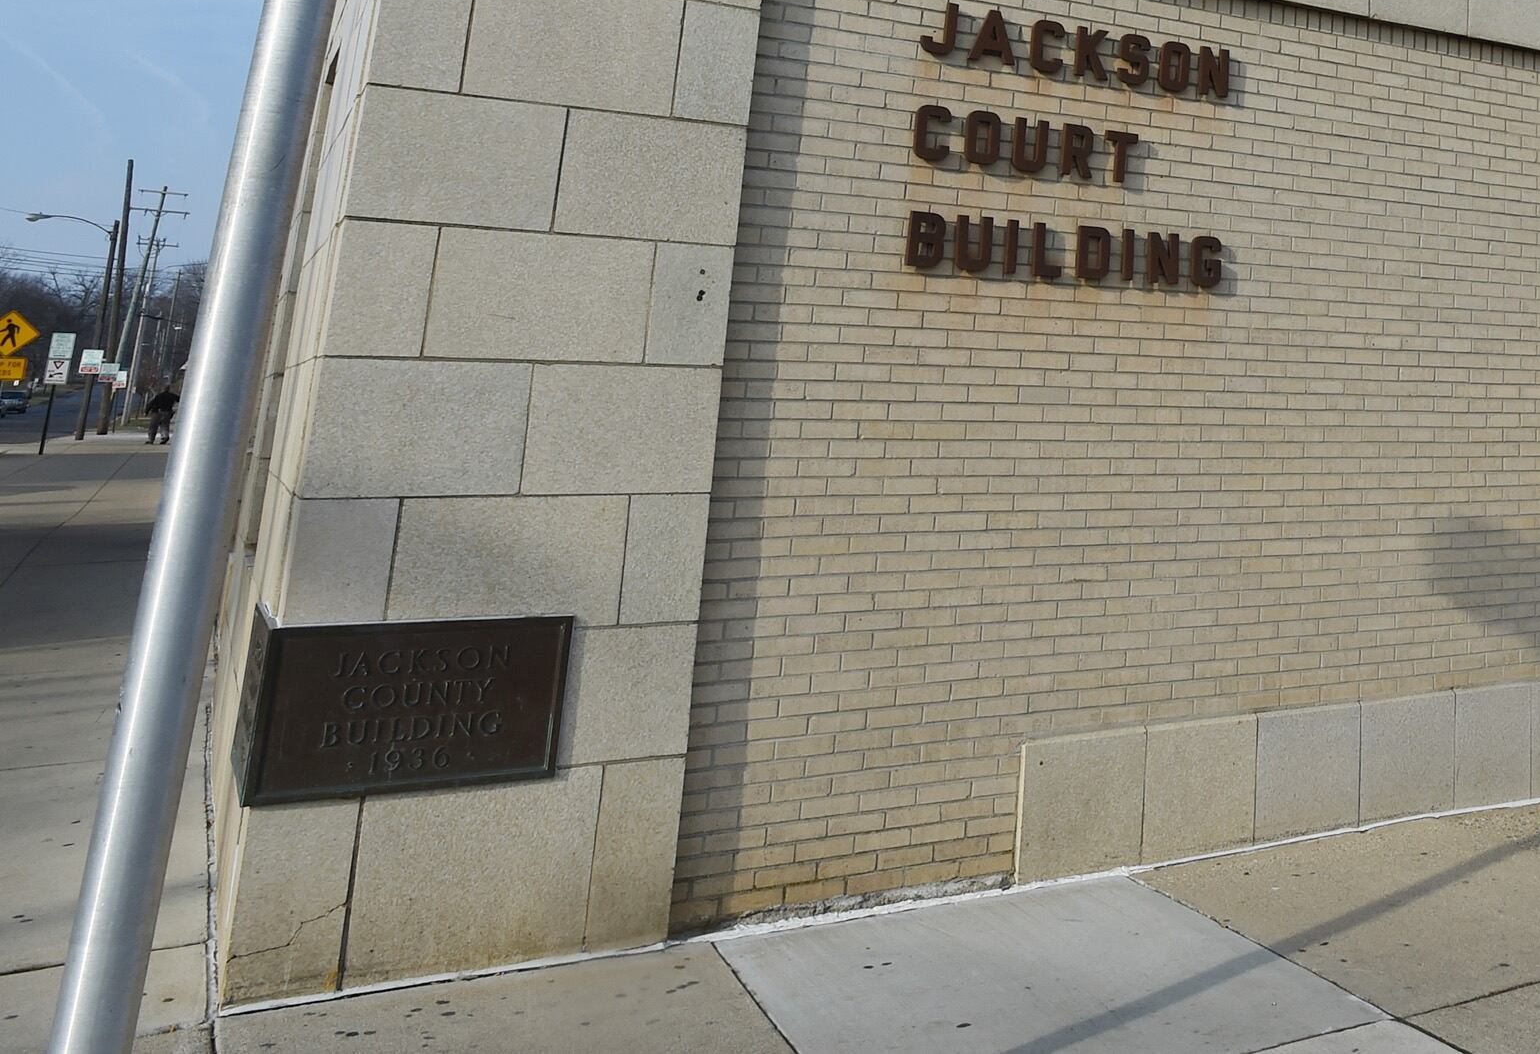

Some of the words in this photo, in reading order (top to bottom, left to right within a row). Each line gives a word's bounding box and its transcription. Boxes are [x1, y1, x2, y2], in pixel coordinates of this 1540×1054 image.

[920, 2, 1230, 99] JACKSON
[912, 104, 1140, 184] COURT
[904, 210, 1223, 288] BUILDING
[329, 643, 511, 677] JACKSON
[341, 677, 496, 712] COUNTY
[320, 709, 504, 748] BUILDING
[368, 746, 450, 775] 1936
